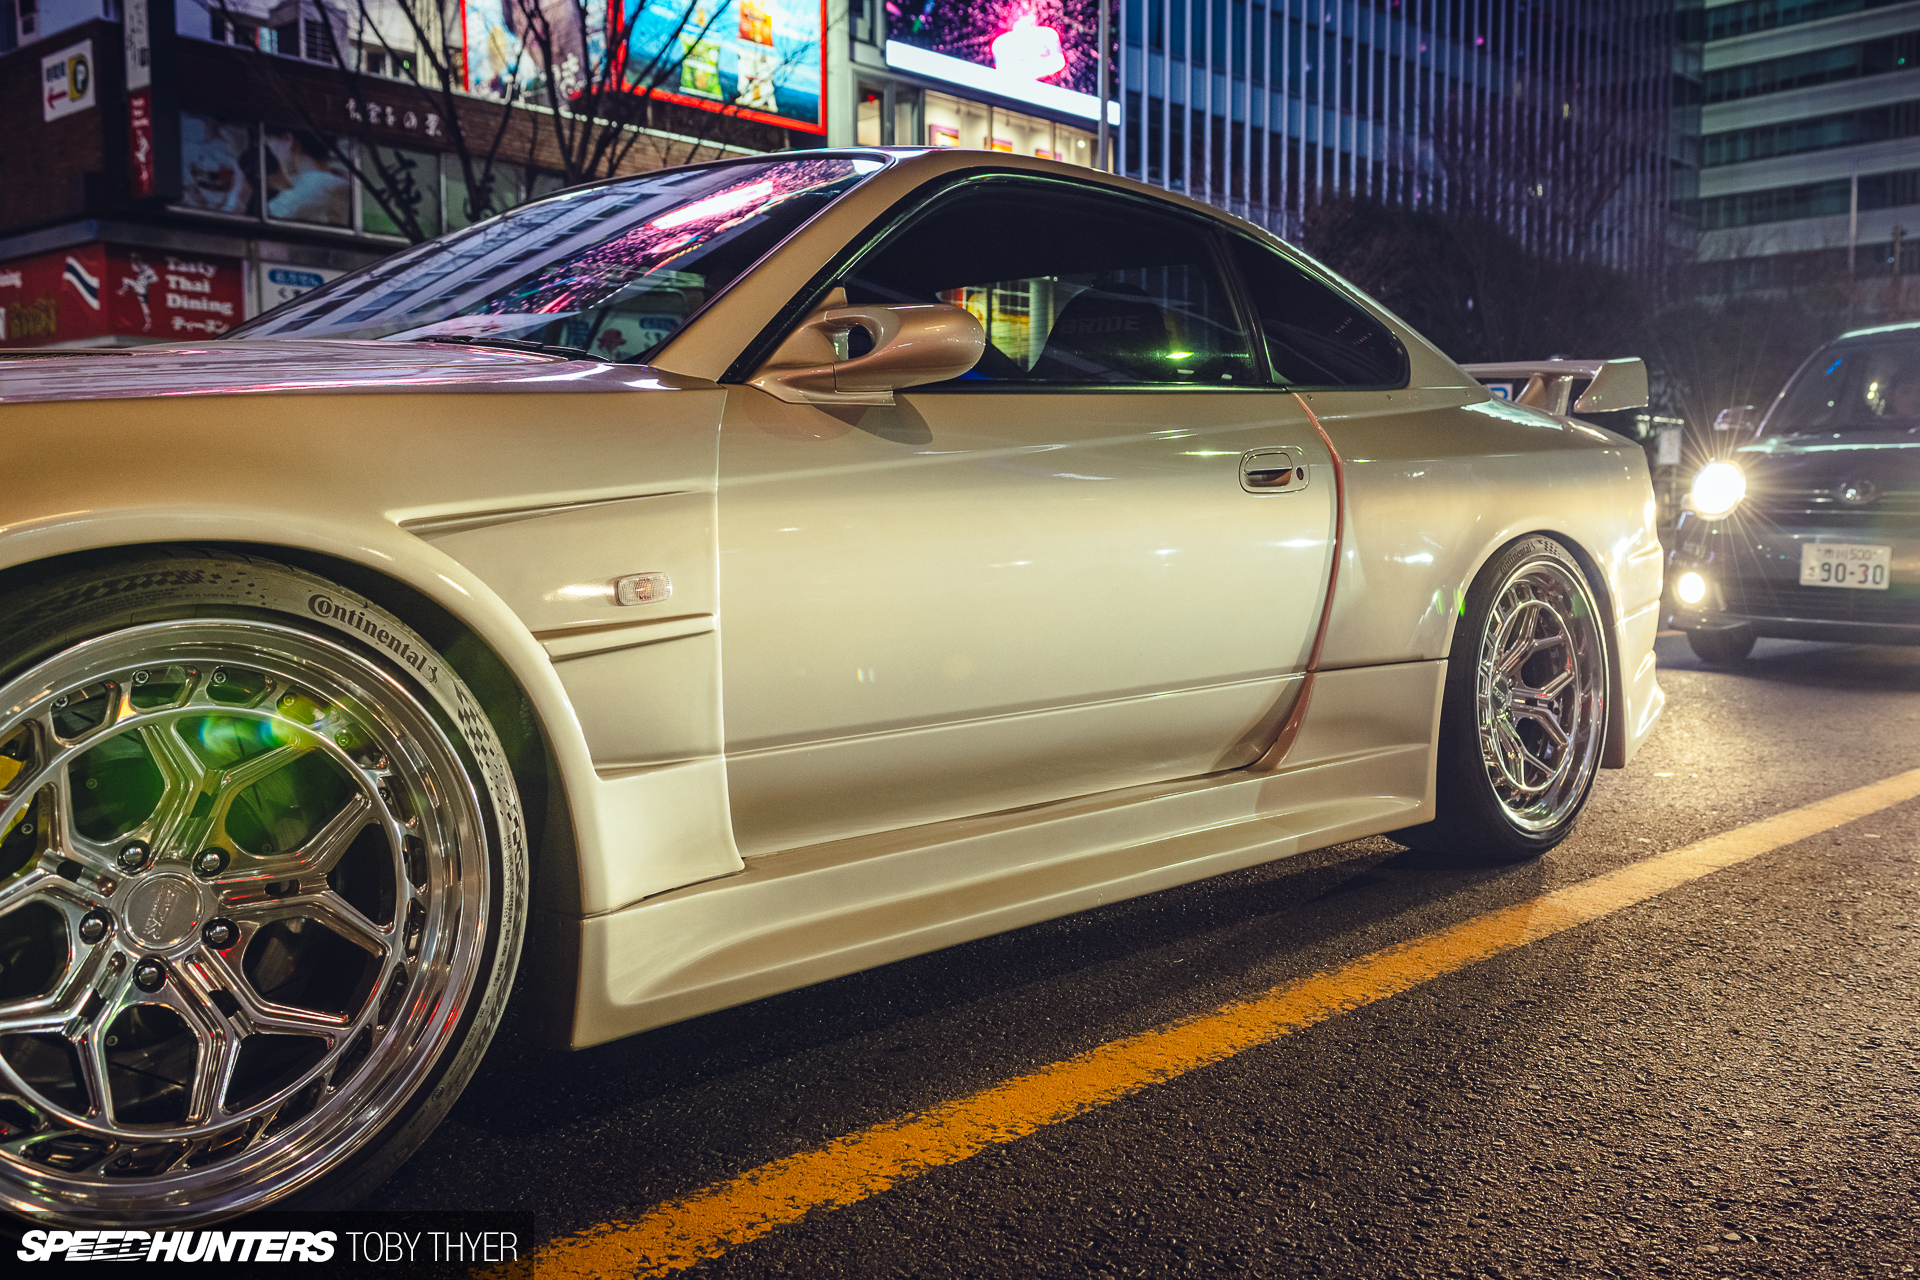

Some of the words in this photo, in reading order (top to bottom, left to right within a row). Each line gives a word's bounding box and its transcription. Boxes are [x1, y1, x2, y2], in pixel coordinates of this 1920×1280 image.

[76, 64, 86, 91] P
[165, 274, 211, 294] Thai
[166, 292, 234, 316] Dining
[1060, 316, 1141, 334] BRIDE
[1501, 543, 1532, 575] Continental
[1821, 562, 1884, 585] 90-30
[308, 594, 427, 673] Continental
